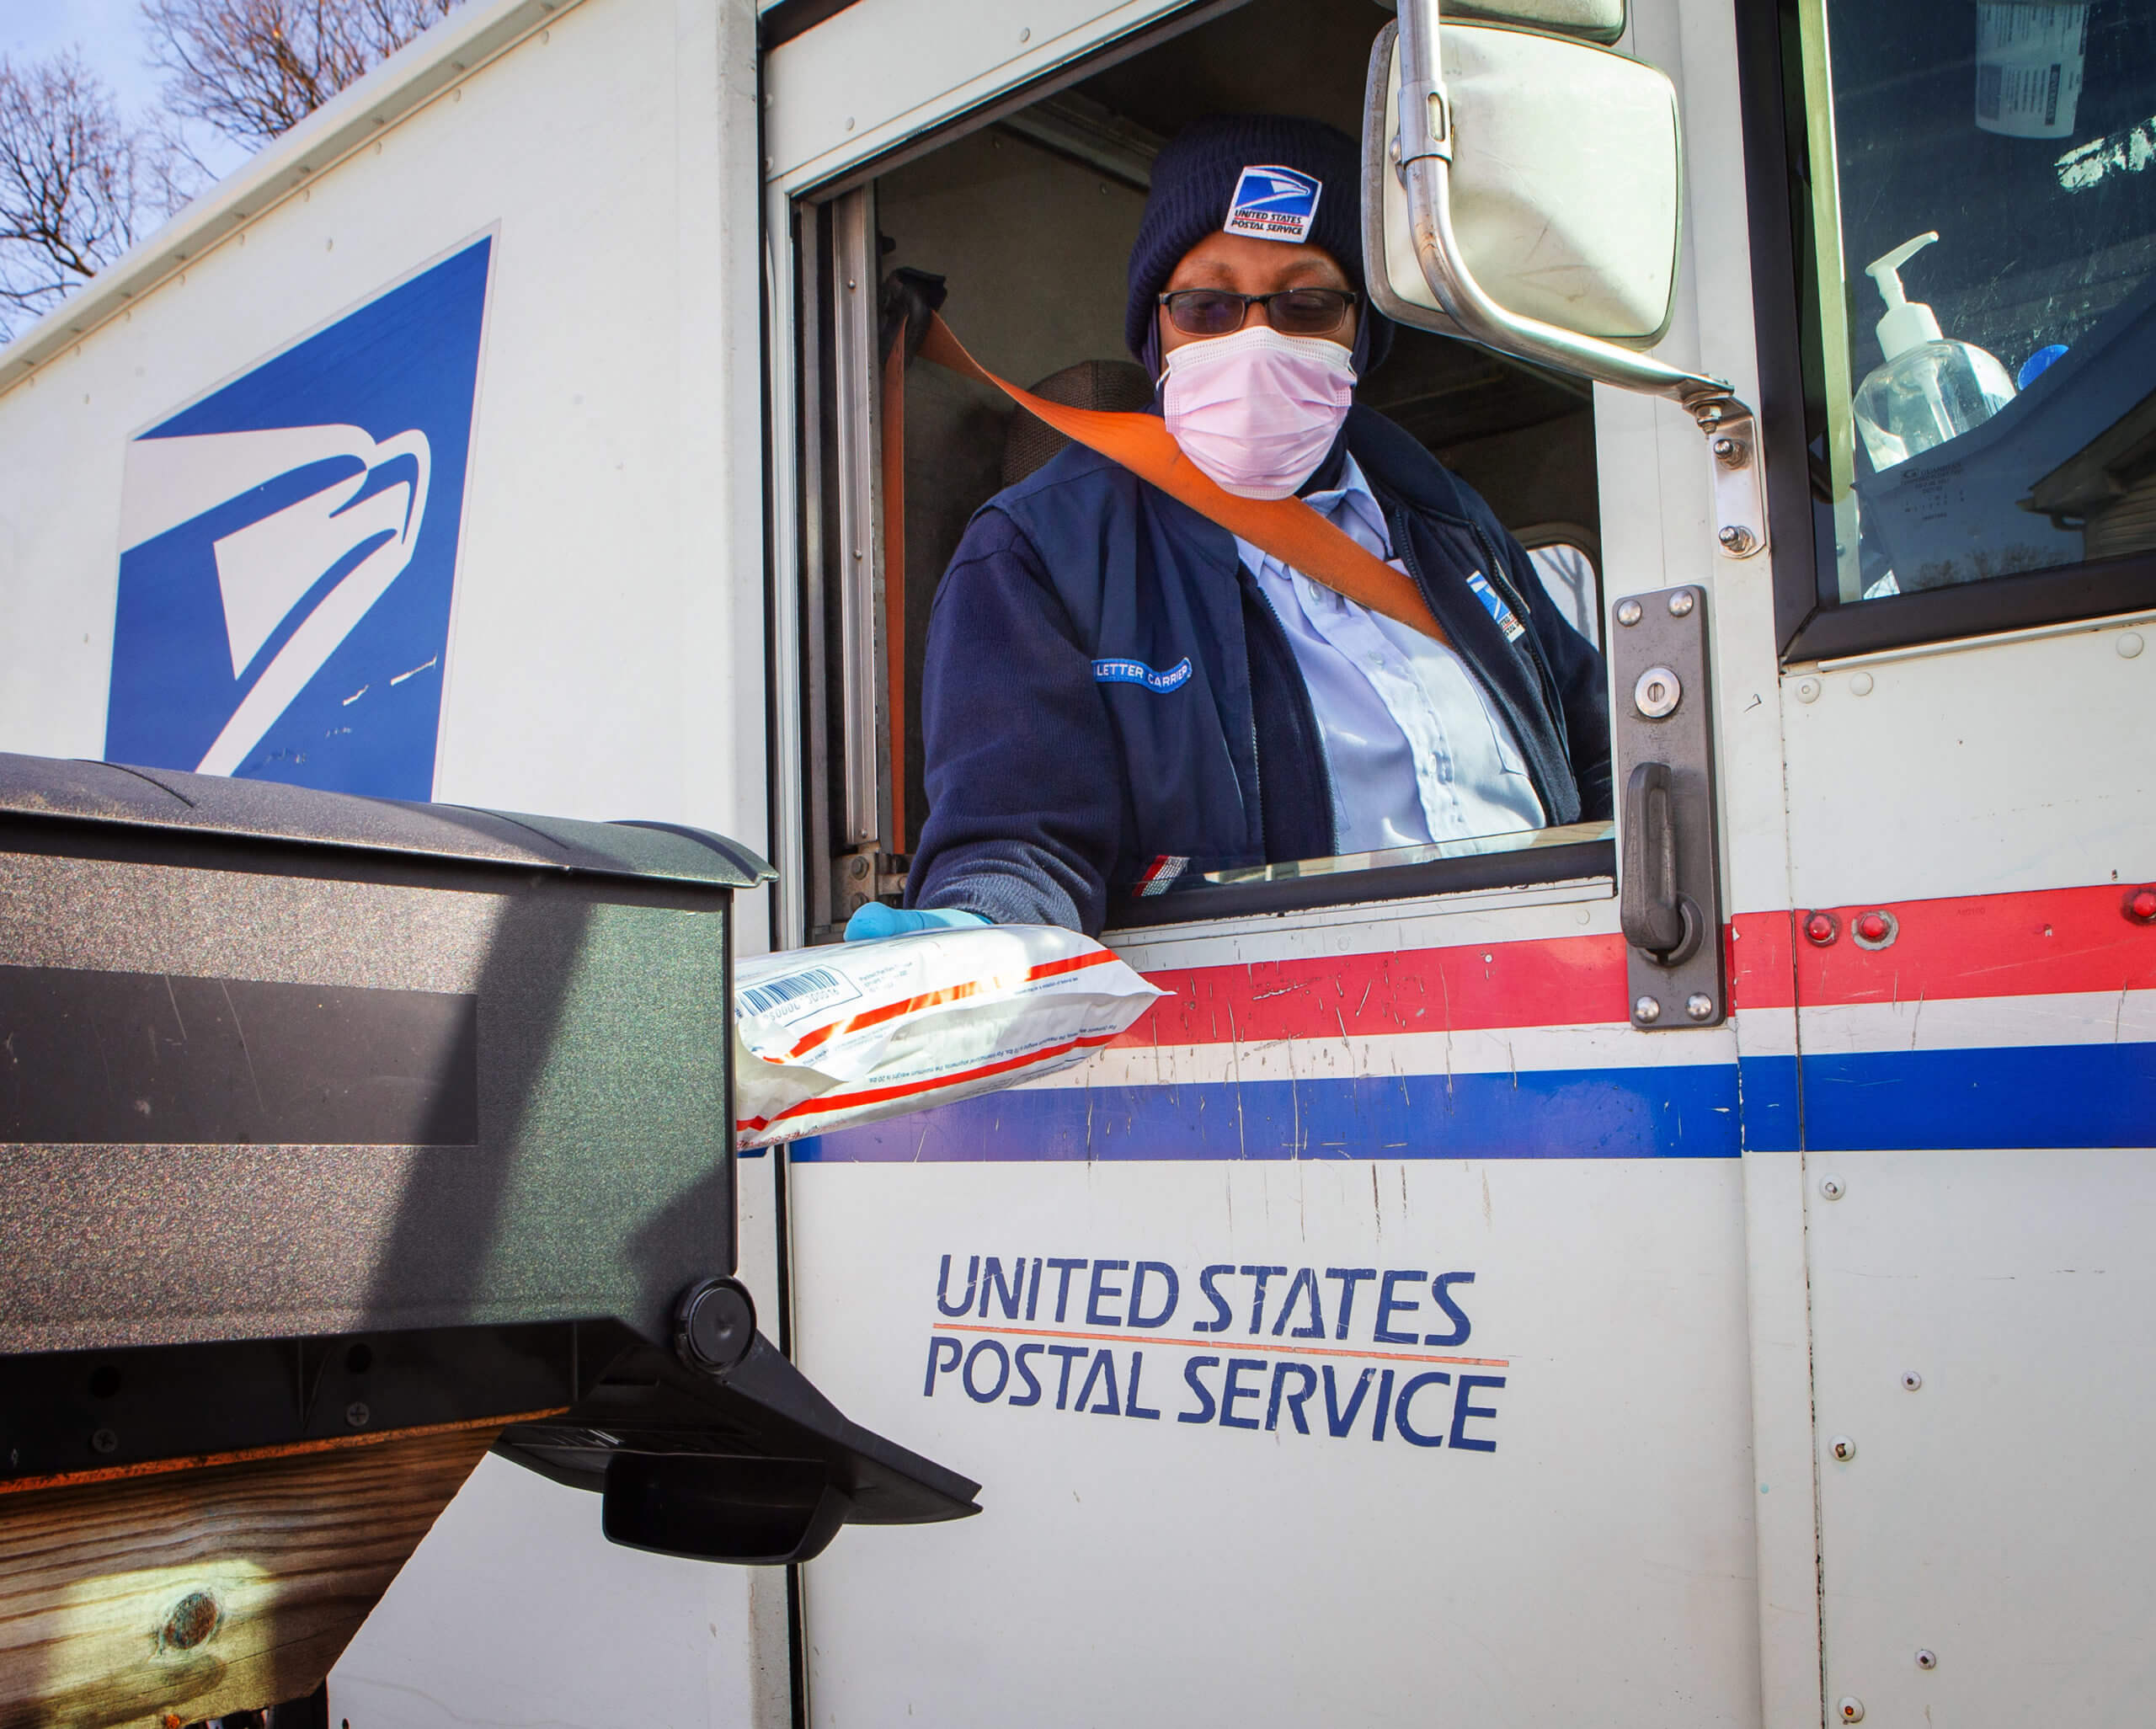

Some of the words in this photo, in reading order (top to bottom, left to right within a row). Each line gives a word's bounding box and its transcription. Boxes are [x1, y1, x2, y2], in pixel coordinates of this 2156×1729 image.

[1231, 220, 1264, 231] POSTAL
[1266, 224, 1303, 235] SERVICE
[1235, 210, 1268, 220] UNITED
[1270, 214, 1301, 224] STATES
[1097, 664, 1144, 679] LETTER
[1148, 666, 1187, 687] CARRIER
[937, 1254, 1179, 1328] UNITED
[1193, 1264, 1476, 1347] STATES
[924, 1336, 1161, 1420] POSTAL
[1177, 1355, 1507, 1453] SERVICE
